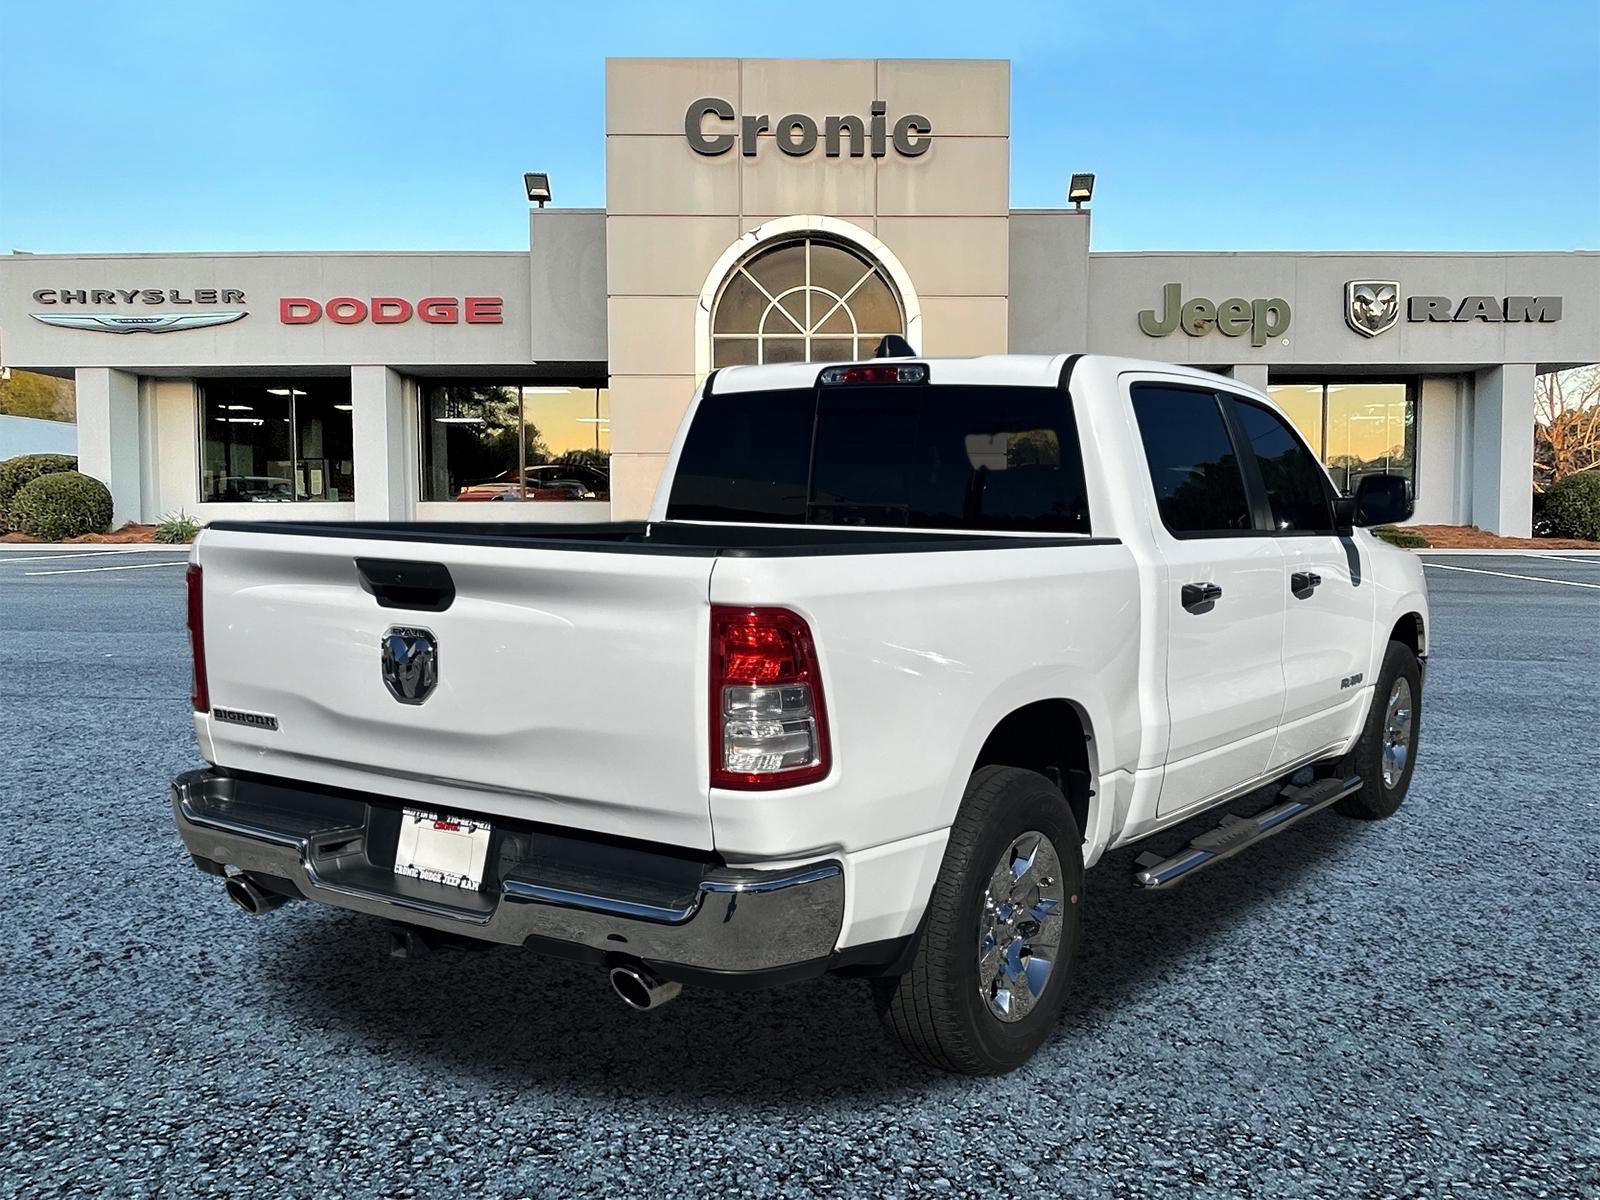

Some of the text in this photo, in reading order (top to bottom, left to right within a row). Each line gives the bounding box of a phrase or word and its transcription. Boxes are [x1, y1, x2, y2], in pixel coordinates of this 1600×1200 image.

[685, 97, 932, 157] Cronic
[32, 288, 247, 304] CHRYSLER
[1407, 295, 1563, 323] RAM
[280, 297, 504, 325] DODGE
[1138, 283, 1291, 347] Jeep
